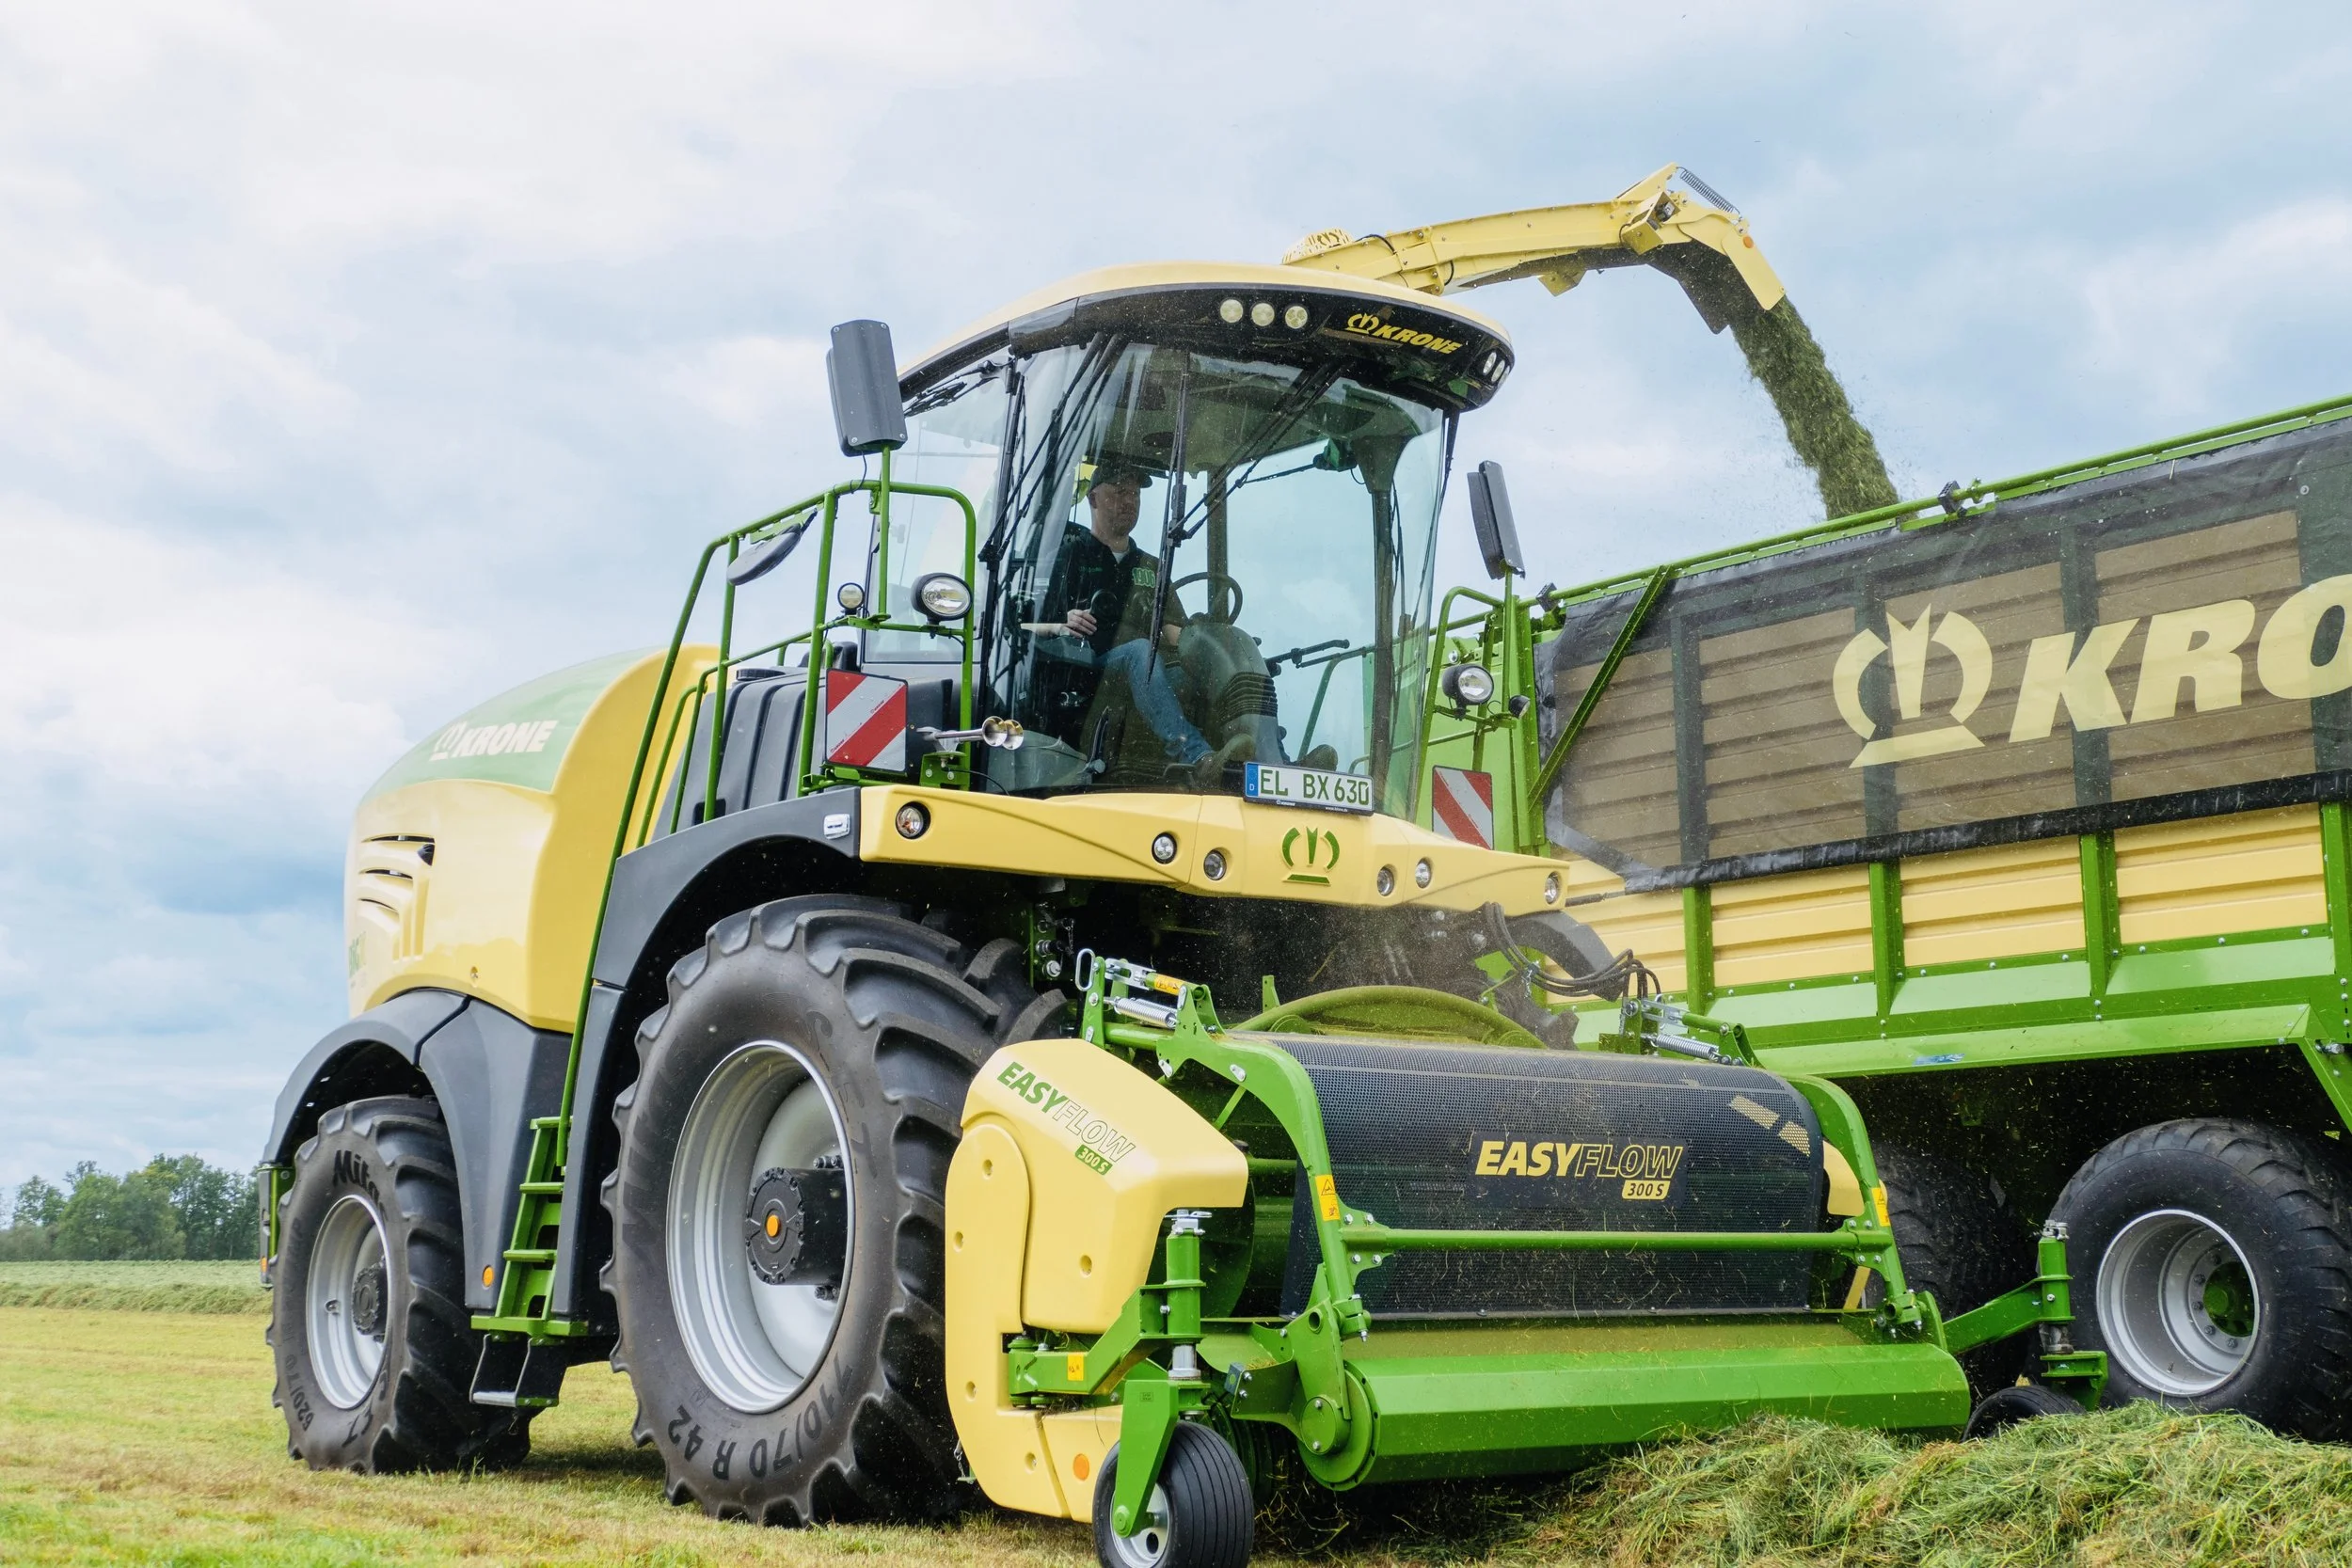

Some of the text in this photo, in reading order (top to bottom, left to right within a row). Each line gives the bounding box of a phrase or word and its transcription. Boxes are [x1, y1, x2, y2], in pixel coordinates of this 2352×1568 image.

[1373, 325, 1463, 355] KRONE
[2009, 574, 2352, 743] KRO
[450, 721, 558, 758] KRONE
[1261, 768, 1288, 797] EL
[1303, 773, 1329, 800] BX
[1334, 778, 1369, 805] 630
[997, 1061, 1136, 1163] EASYFLOW
[1077, 1148, 1109, 1172] 300 S
[1475, 1140, 1683, 1178] EASYFLOW
[1628, 1183, 1664, 1196] 300 S
[667, 1352, 852, 1481] 710/70 R 42
